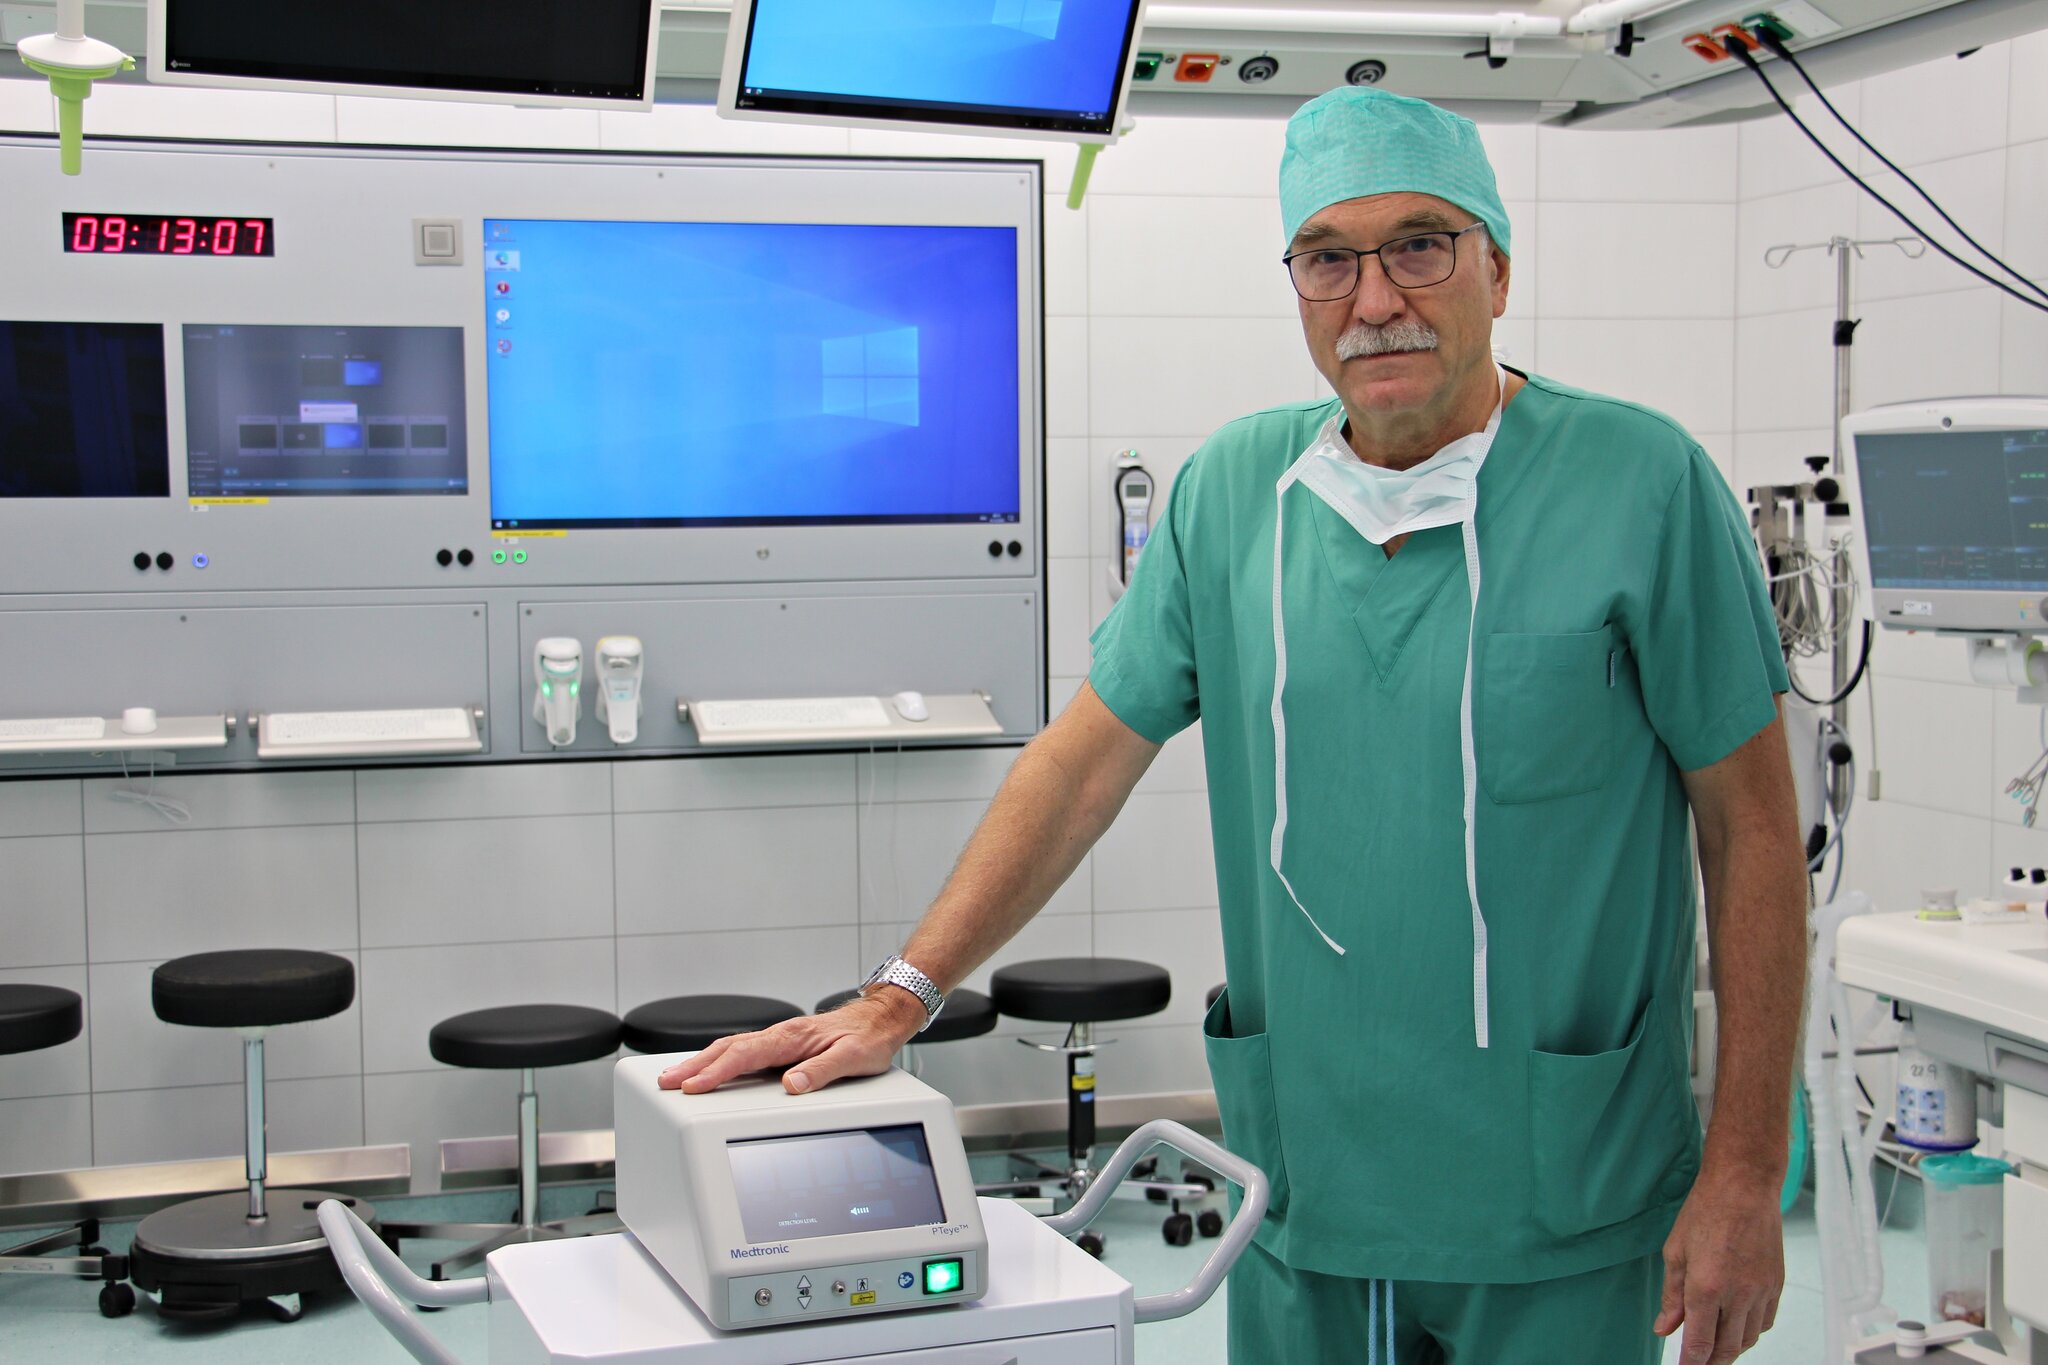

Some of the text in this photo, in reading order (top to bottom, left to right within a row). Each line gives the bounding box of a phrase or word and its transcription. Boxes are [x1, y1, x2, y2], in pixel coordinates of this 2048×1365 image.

[74, 217, 264, 254] 09:13:07
[778, 1218, 803, 1227] DETECTION
[730, 1244, 790, 1259] Medtronic
